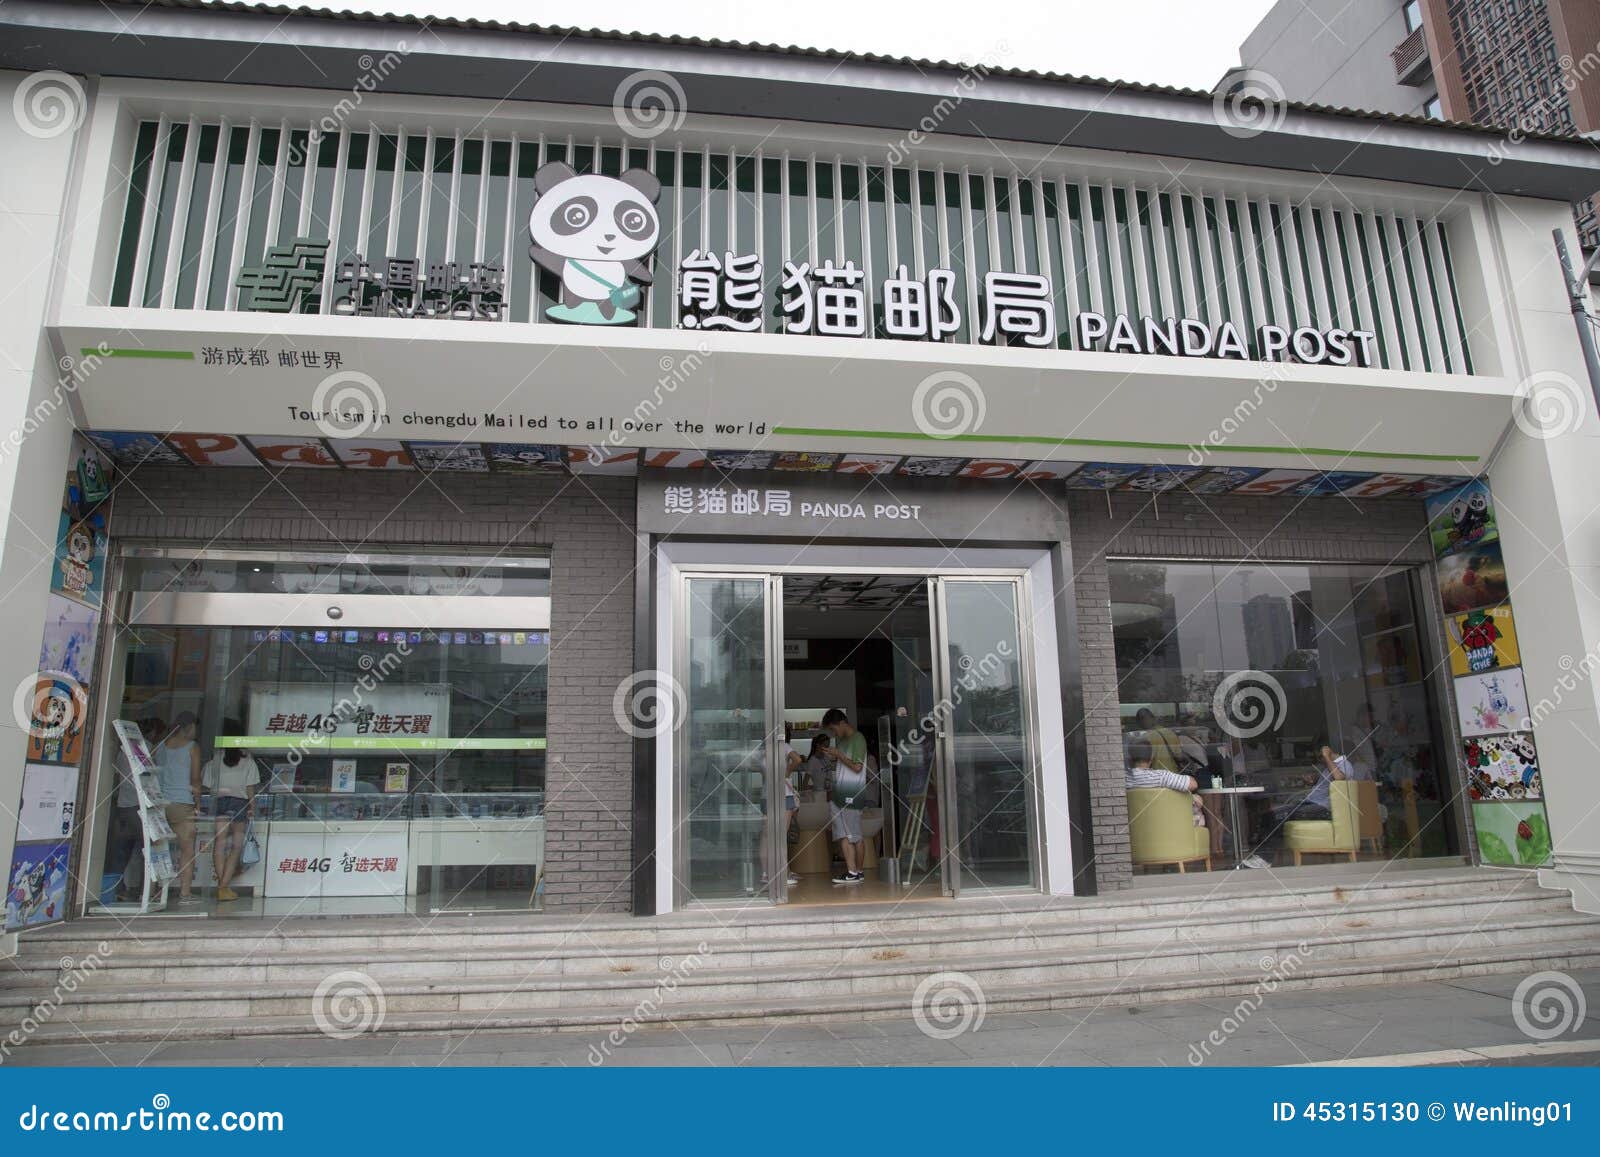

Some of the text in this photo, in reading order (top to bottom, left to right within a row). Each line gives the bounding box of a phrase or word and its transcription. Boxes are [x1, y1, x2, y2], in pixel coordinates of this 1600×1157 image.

[336, 254, 506, 294] 中国邮政
[682, 249, 1055, 346] 熊猫邮局
[1079, 312, 1375, 365] PANDA POST
[201, 346, 344, 370] 游成都 邮世界
[288, 406, 766, 436] Tourism in chengdu Mailed to all over the world
[664, 486, 792, 516] 熊猫邮局
[800, 502, 921, 520] PANDA POST
[1467, 645, 1494, 660] PANDA
[265, 705, 432, 734] 卓越4G 智选天翼
[278, 852, 398, 873] 卓越4G 智选天翼
